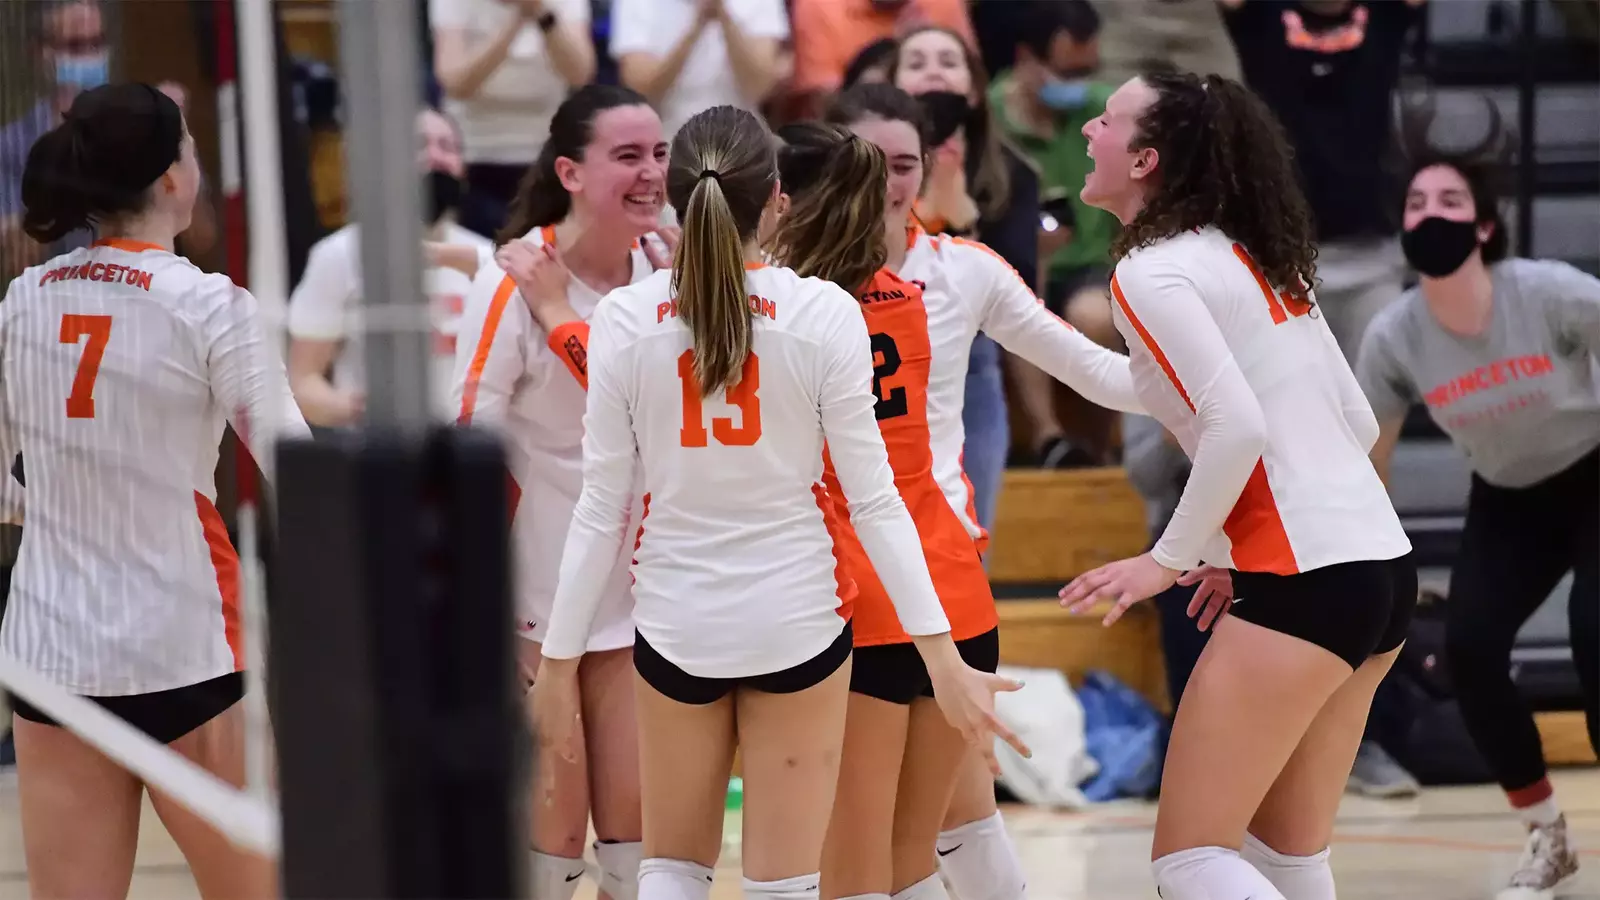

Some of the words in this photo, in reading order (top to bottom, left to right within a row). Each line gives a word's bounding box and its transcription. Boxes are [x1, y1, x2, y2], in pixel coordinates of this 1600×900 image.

[39, 260, 154, 292] PRINCETON
[60, 314, 112, 418] 7
[677, 348, 762, 447] 13
[1424, 355, 1554, 408] PRINCETON
